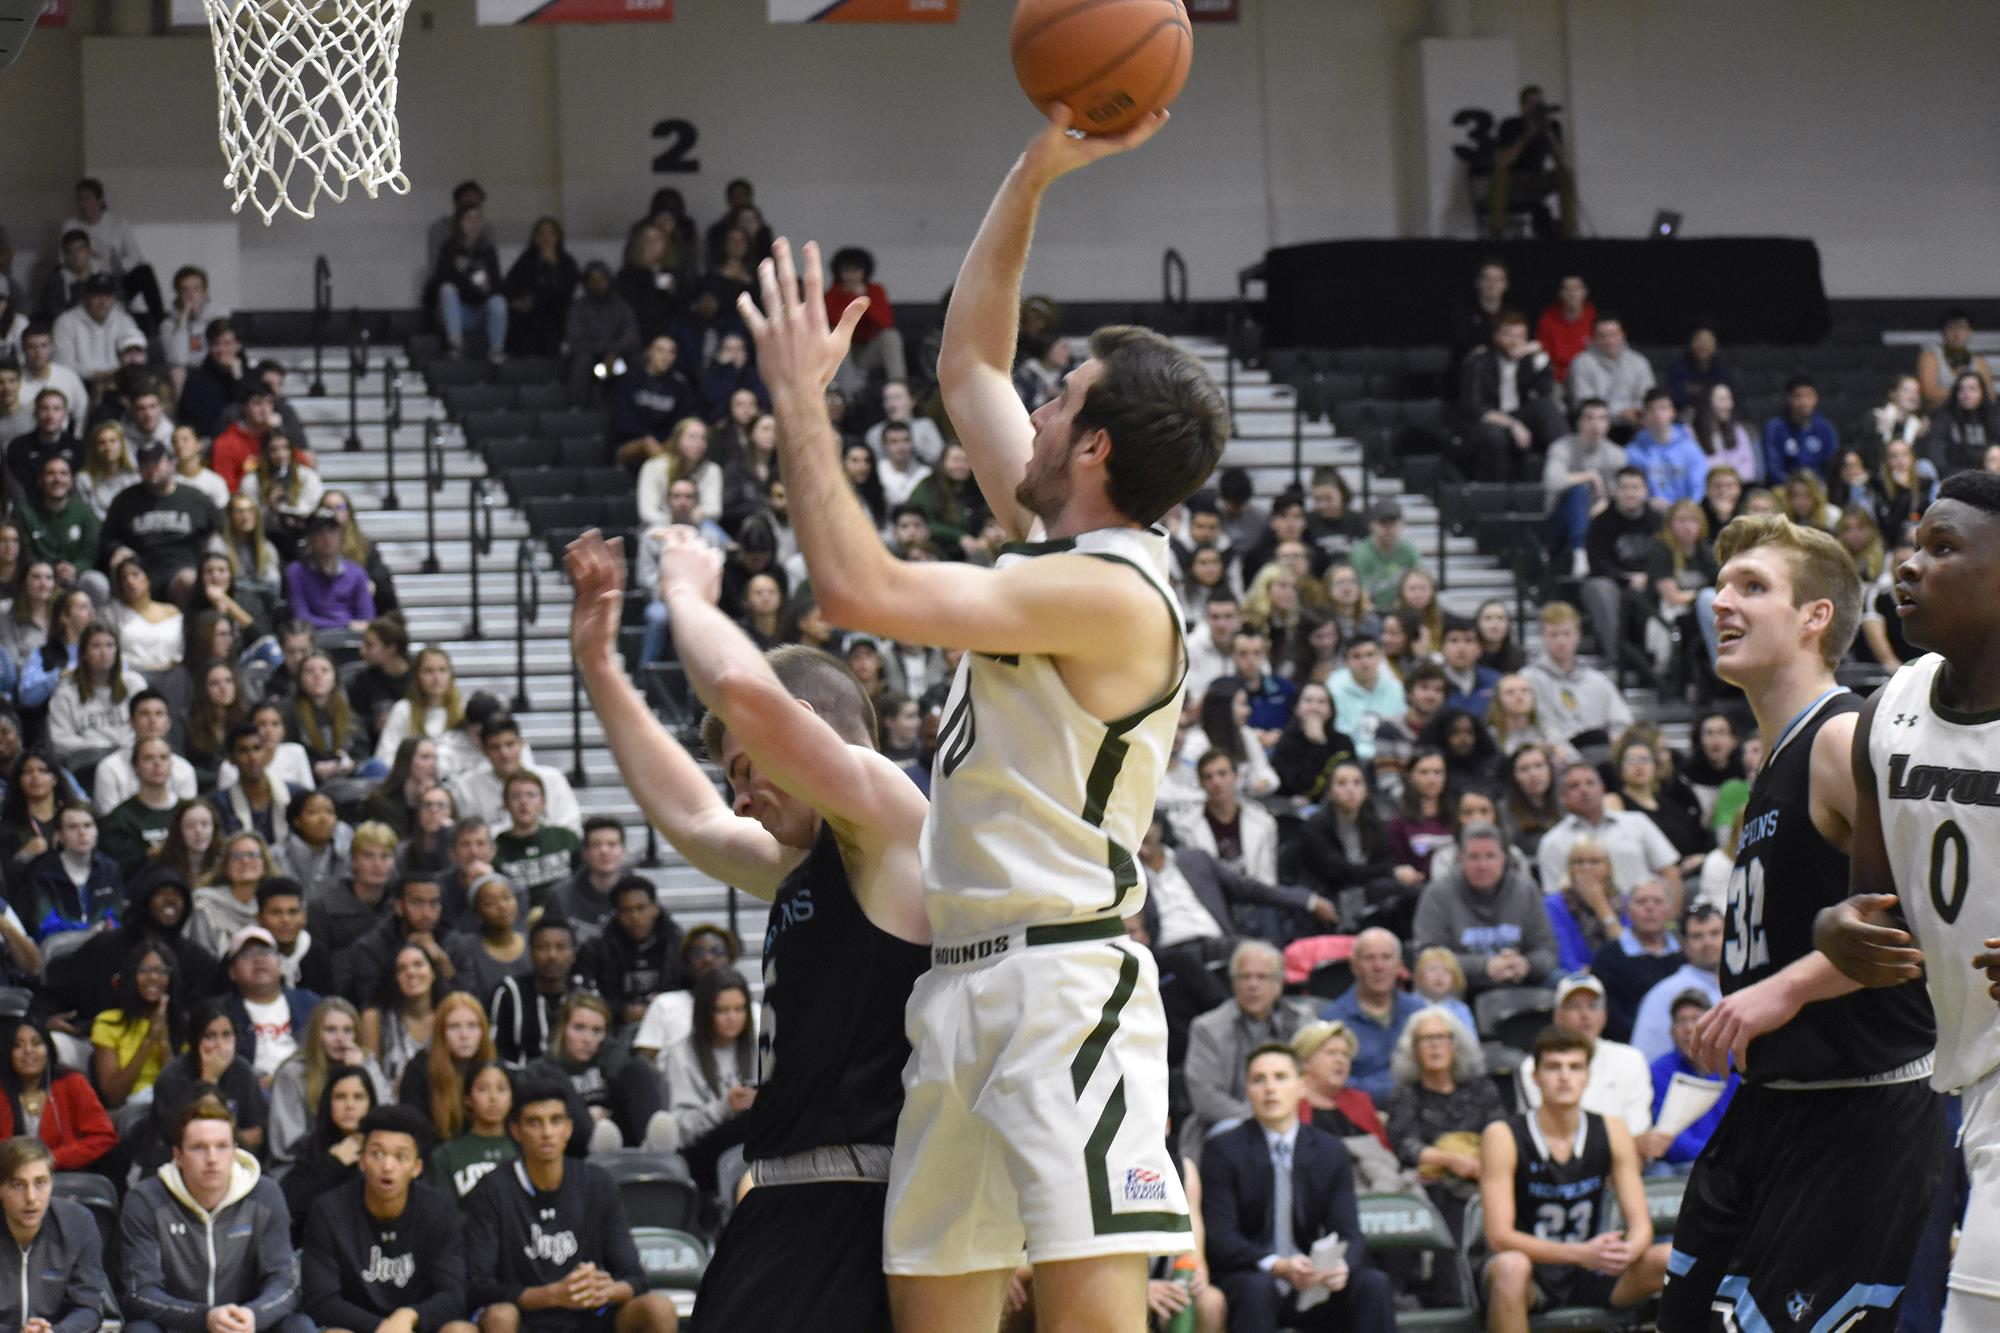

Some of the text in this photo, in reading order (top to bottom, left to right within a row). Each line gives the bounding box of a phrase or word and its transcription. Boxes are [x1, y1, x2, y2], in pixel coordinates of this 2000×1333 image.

[651, 119, 700, 174] 2
[1451, 109, 1498, 170] 3
[1888, 754, 2000, 807] LOYOL
[1929, 819, 1969, 925] 0
[1725, 856, 1770, 976] 32
[523, 1222, 578, 1266] Jays
[1534, 1199, 1594, 1244] 23
